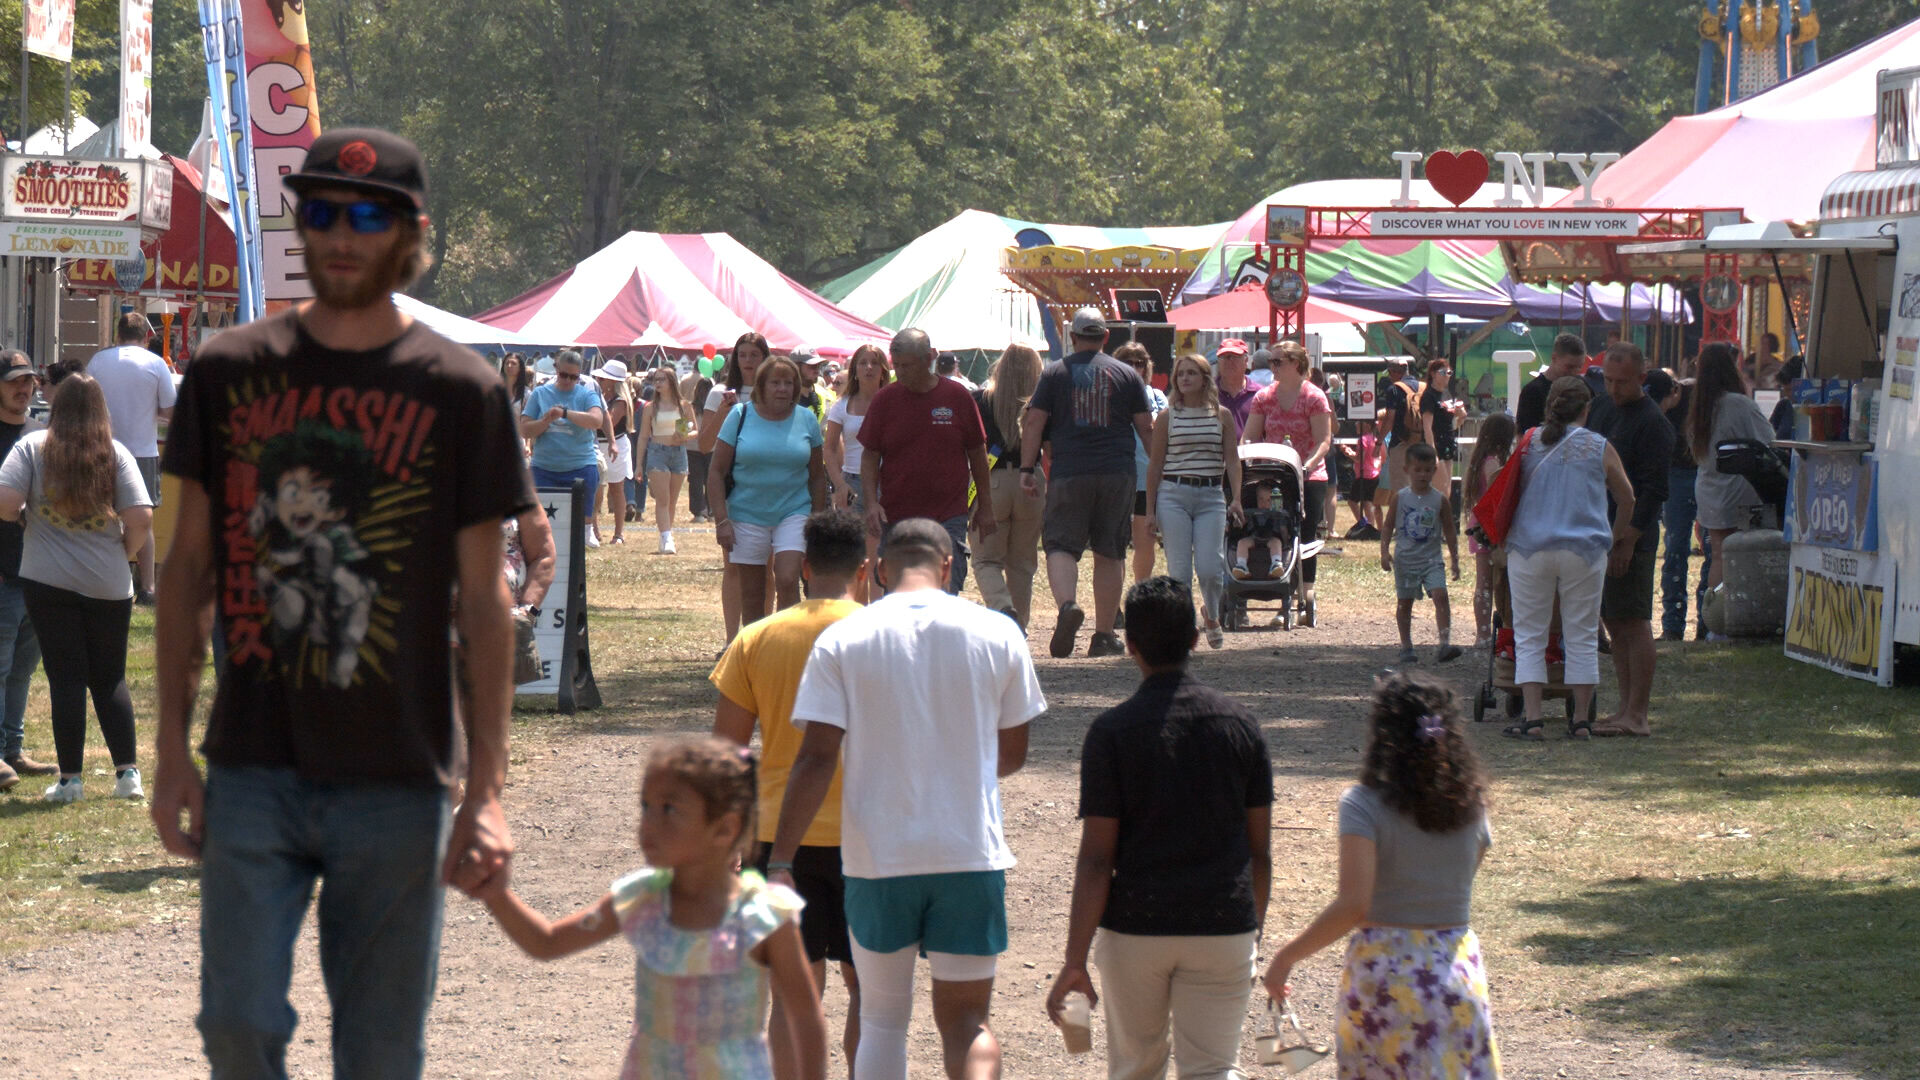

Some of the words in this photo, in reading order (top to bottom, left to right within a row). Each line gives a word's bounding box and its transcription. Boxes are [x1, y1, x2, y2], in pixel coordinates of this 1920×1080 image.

[51, 165, 97, 177] FRUIT
[1390, 151, 1422, 207] I
[1493, 151, 1620, 207] NY
[15, 177, 129, 209] SMOOTHIES
[15, 226, 57, 235] FRESH
[60, 228, 124, 237] SQUEEZED
[1382, 219, 1443, 229] DISCOVER
[1446, 219, 1481, 229] WHAT
[1484, 219, 1510, 229] YOU
[1513, 219, 1545, 229] LOVE
[1548, 219, 1560, 229] IN
[1563, 219, 1592, 229] NEW
[1595, 219, 1627, 229] YORK
[8, 234, 129, 257] LEMONADE
[1811, 494, 1849, 534] OREO
